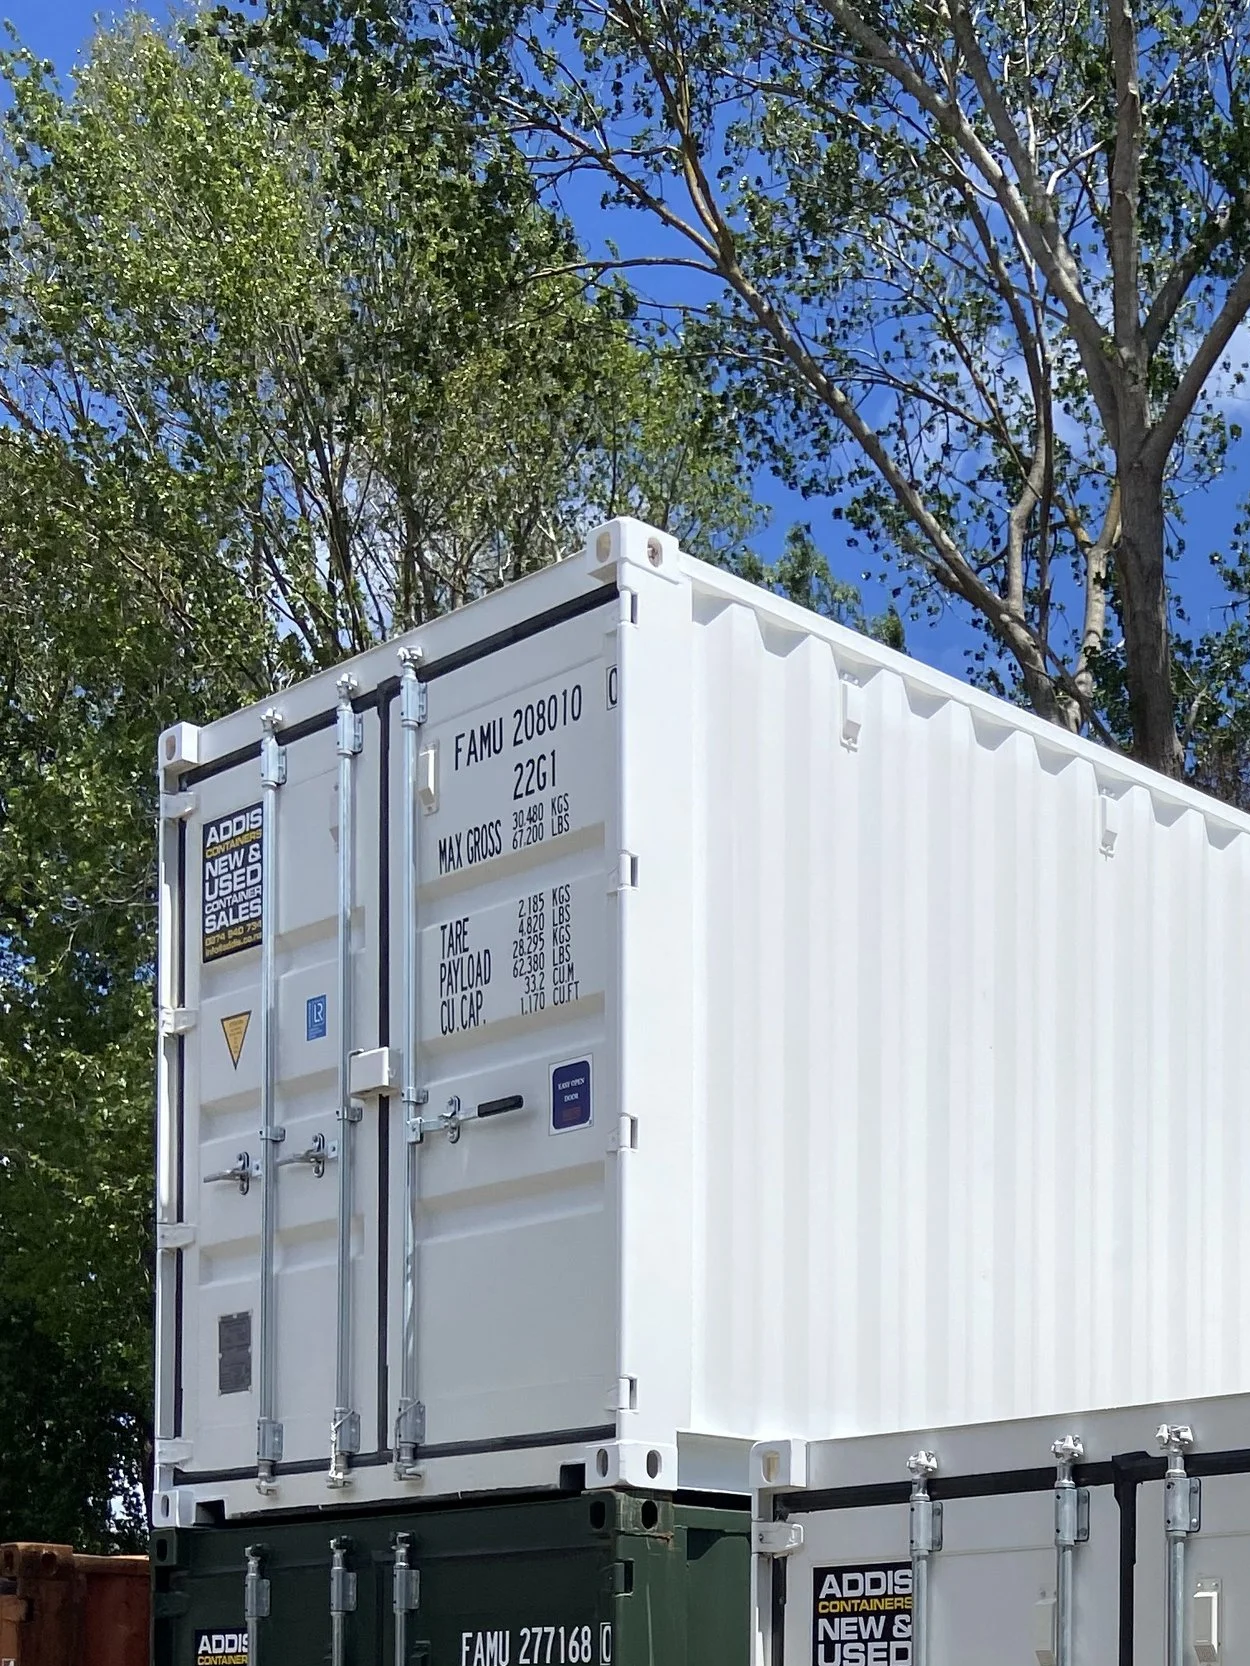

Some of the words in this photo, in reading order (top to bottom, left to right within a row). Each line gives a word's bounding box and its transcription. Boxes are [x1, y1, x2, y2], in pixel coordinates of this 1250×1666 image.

[454, 717, 503, 771] FAMU
[513, 684, 582, 747] 208010
[513, 749, 556, 801] 22G1
[206, 808, 262, 848] ADDIS
[438, 832, 462, 875] MAX
[467, 819, 502, 864] GROSS
[551, 793, 570, 817] KGS
[552, 813, 570, 836] LBS
[206, 829, 262, 858] CONTAINERS
[205, 848, 244, 880] NEW
[248, 843, 261, 863] &
[205, 863, 262, 901] USED
[205, 885, 262, 914] CONTAINER
[205, 898, 262, 934] SALES
[552, 904, 571, 927] LBS
[440, 917, 469, 960] TARE
[552, 884, 571, 907] KGS
[440, 949, 491, 999] PAYLOAD
[552, 924, 571, 947] KGS
[553, 944, 571, 967] LBS
[524, 971, 545, 994] 33.2
[818, 1568, 912, 1599] ADDIS
[818, 1597, 912, 1613] CONTAINERS
[818, 1615, 886, 1642] NEW
[892, 1614, 912, 1638] &
[197, 1654, 248, 1665] CONTAINER
[519, 1626, 592, 1665] 277168
